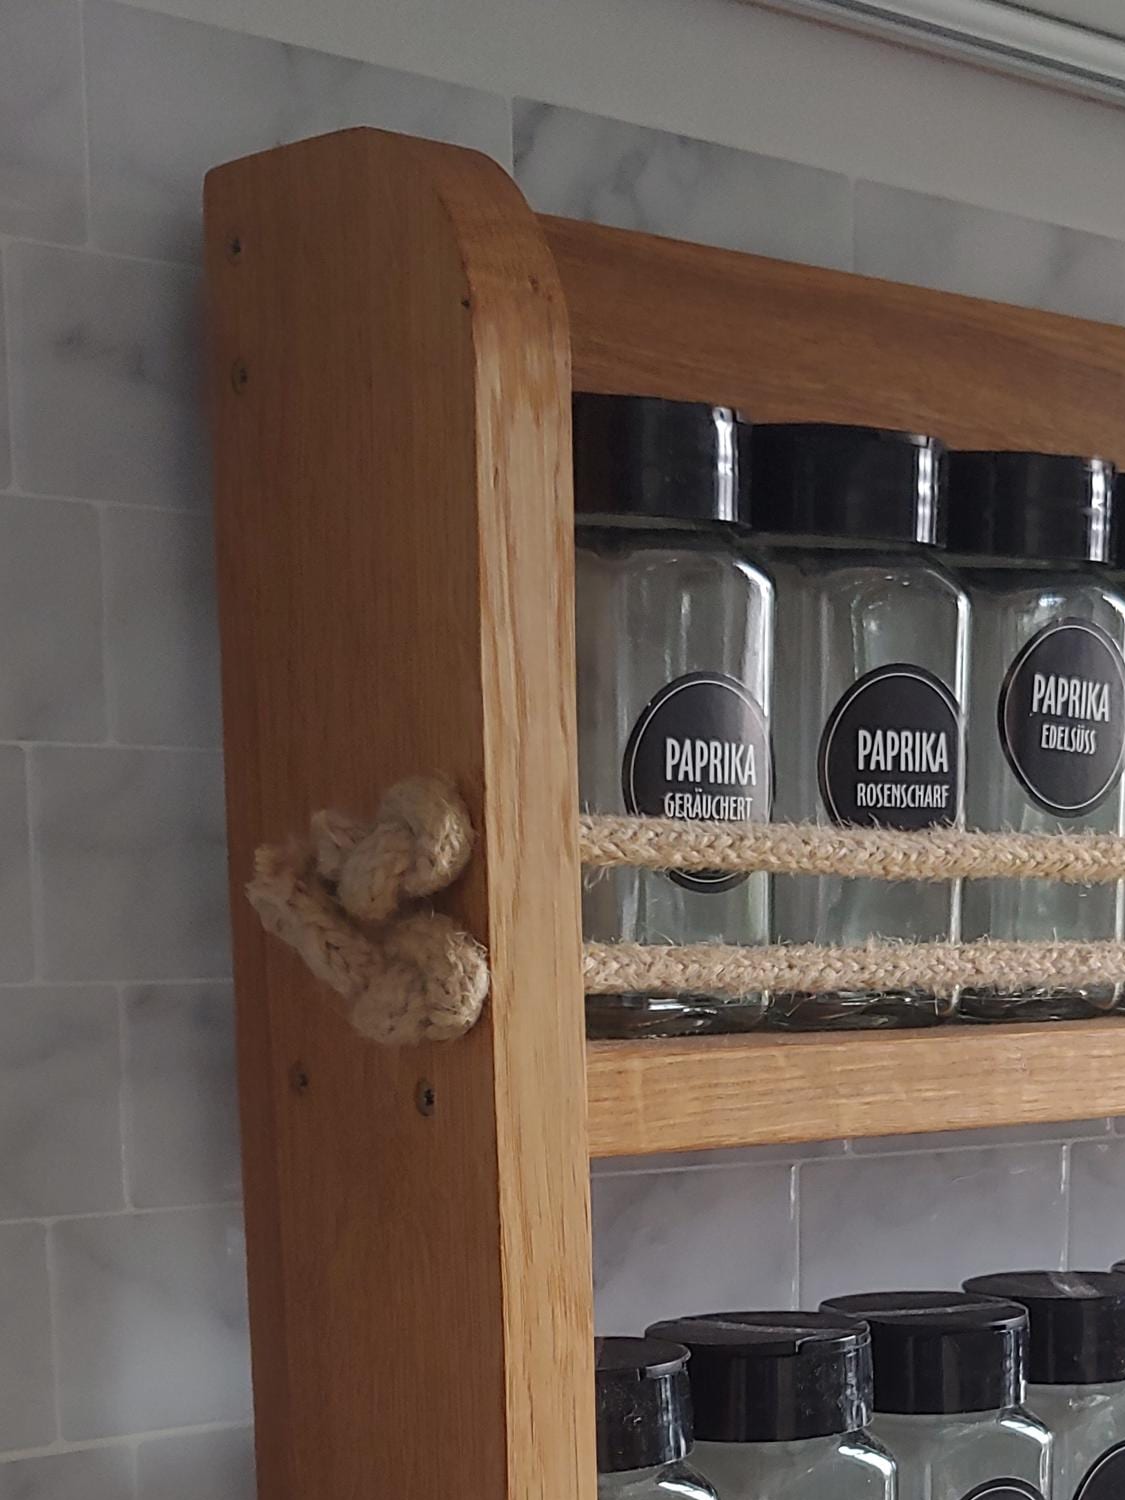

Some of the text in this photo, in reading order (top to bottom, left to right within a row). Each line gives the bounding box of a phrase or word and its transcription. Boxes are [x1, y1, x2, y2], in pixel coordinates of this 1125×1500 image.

[1032, 673, 1111, 722] PAPRIKA
[858, 728, 948, 773] PAPRIKA
[1041, 723, 1096, 755] EDELSÜSS
[664, 737, 757, 786] PAPRIKA
[664, 788, 753, 821] GERÄUCHERT
[856, 782, 949, 809] ROSENSCHARF
